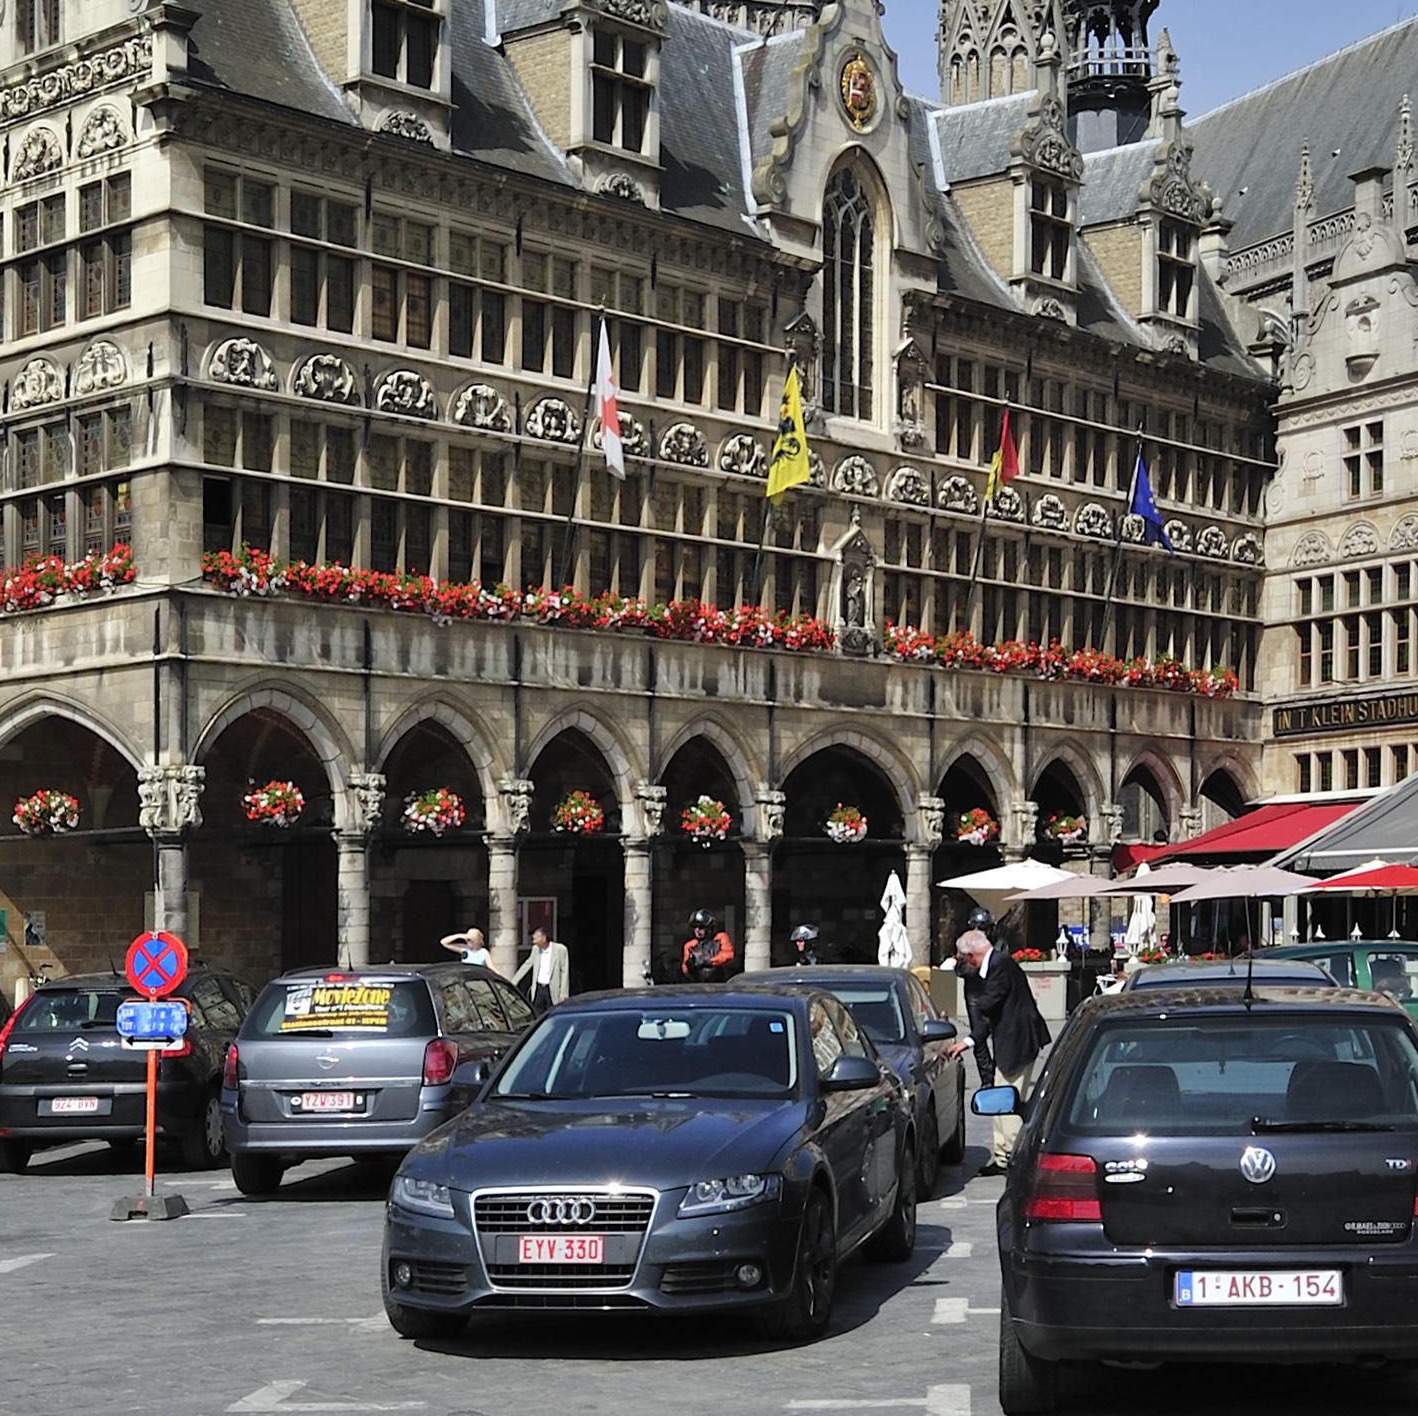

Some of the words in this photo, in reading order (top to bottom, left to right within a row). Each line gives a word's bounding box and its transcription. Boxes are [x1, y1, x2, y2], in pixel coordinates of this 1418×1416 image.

[1311, 703, 1355, 728] KLEIN
[312, 986, 391, 1006] MovieZone
[1182, 1289, 1191, 1301] B
